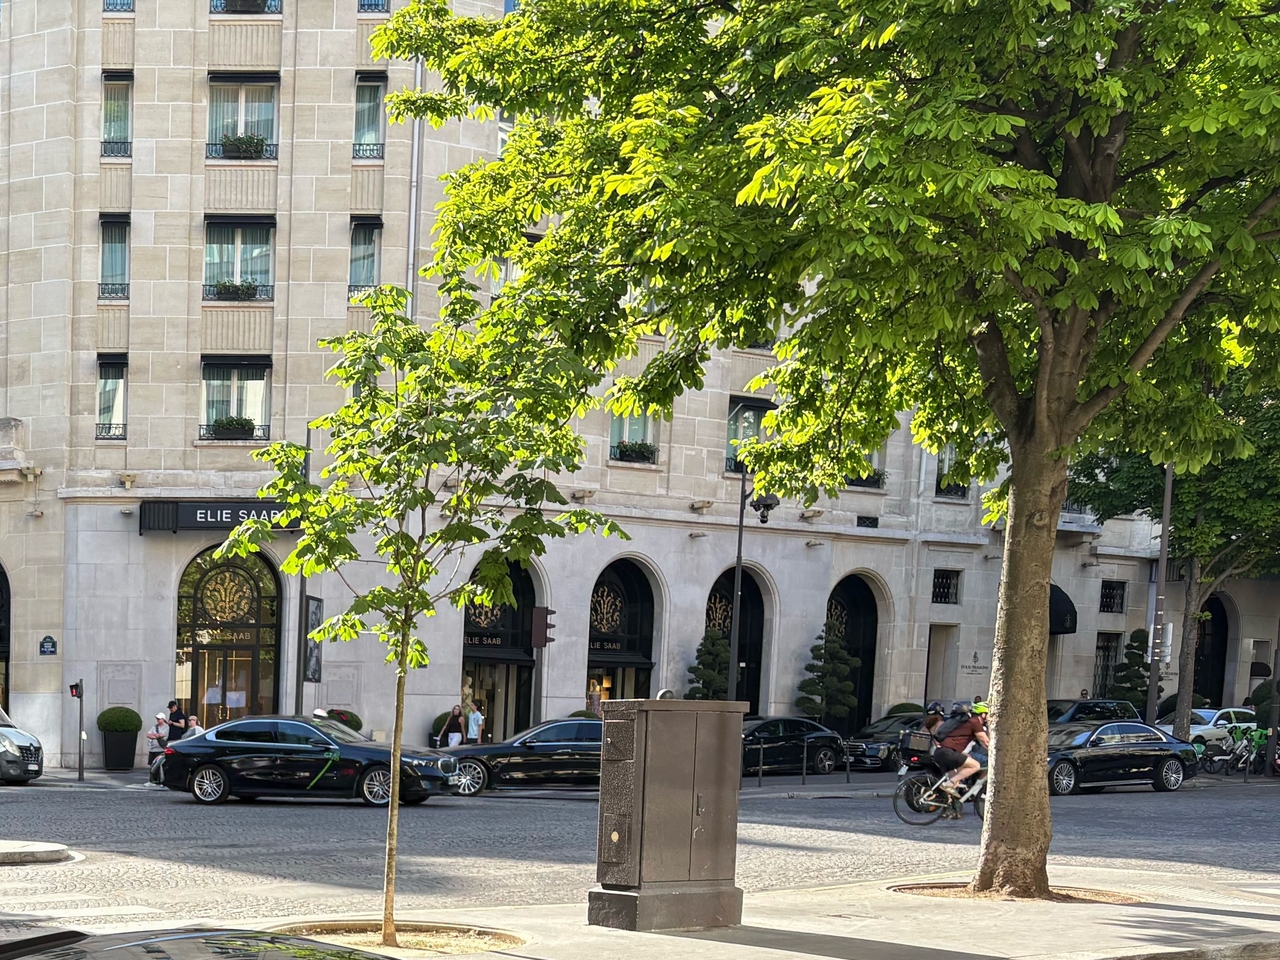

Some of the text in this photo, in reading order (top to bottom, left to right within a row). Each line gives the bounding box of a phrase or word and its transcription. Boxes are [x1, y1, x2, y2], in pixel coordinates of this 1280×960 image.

[196, 509, 232, 522] ELIE
[226, 632, 251, 640] SAAB
[482, 637, 502, 645] SAAB
[588, 641, 621, 650] LIE SAAB
